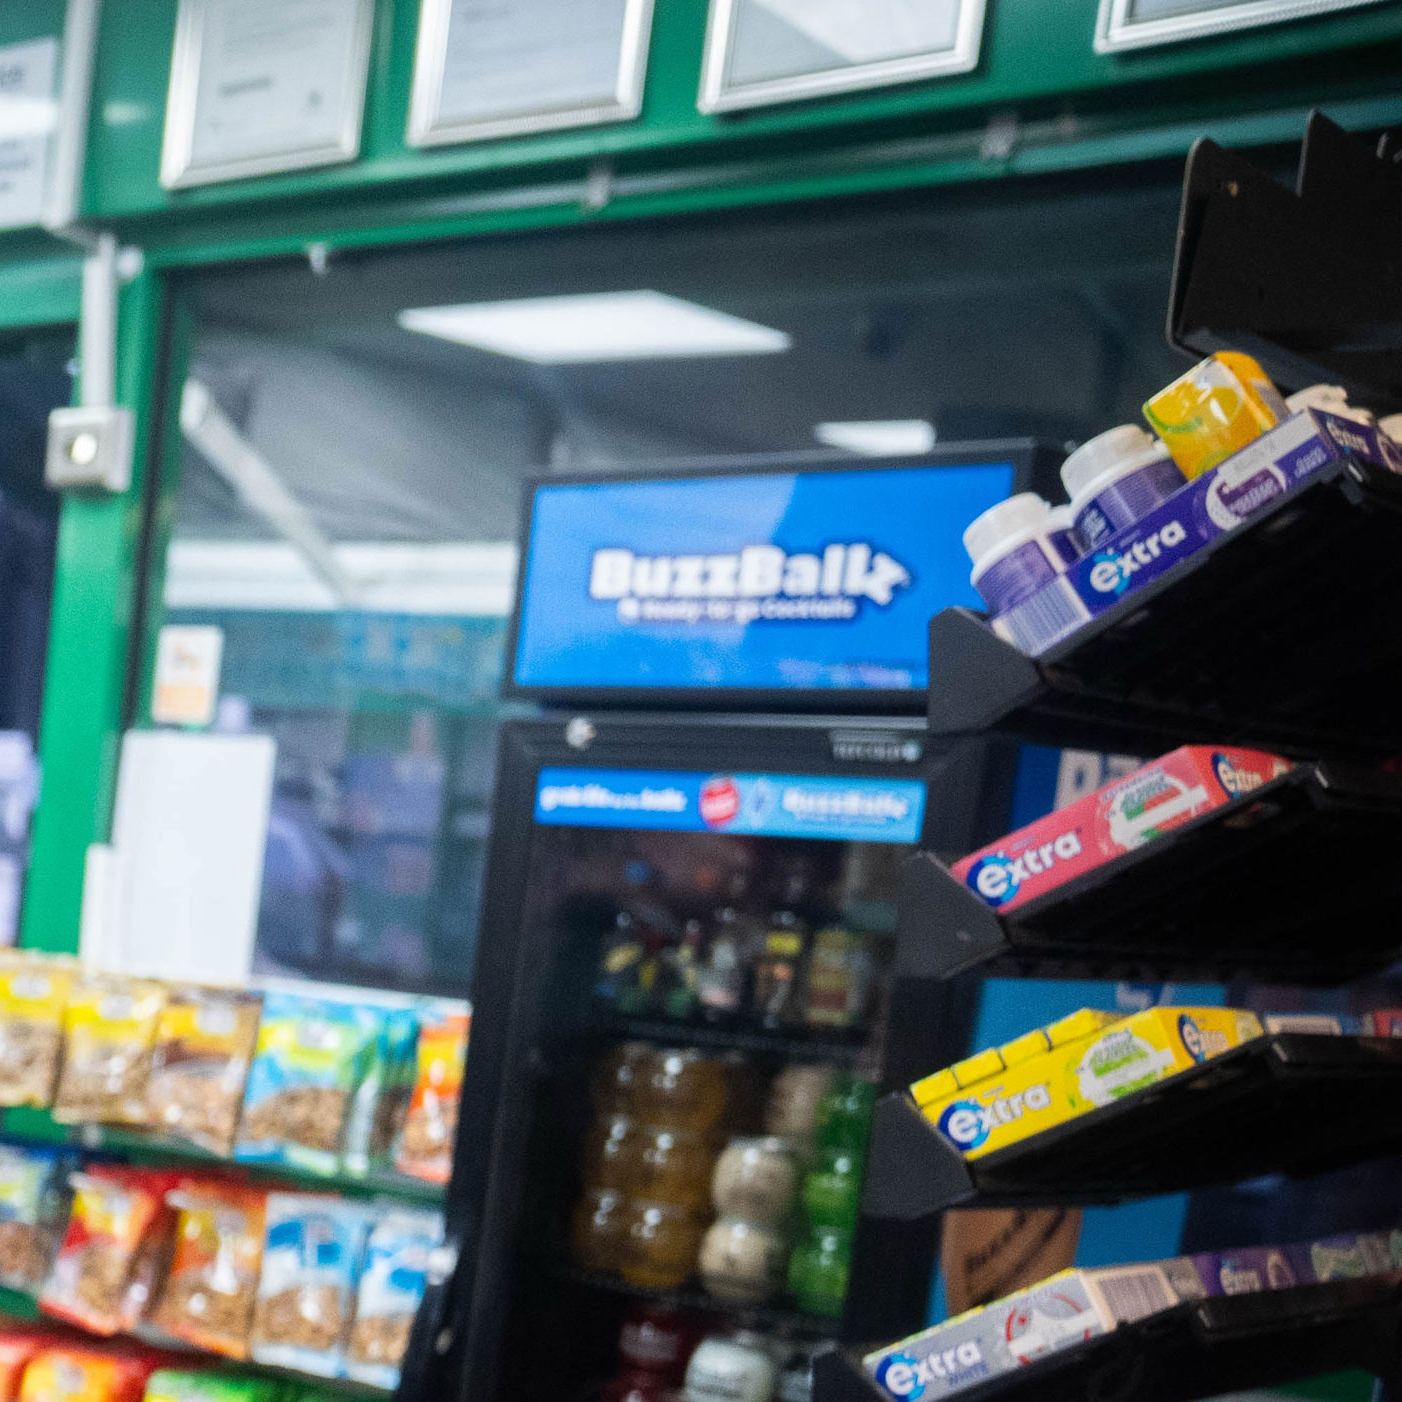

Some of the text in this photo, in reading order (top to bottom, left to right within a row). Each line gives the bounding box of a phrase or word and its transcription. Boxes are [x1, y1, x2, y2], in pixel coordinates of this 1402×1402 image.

[1090, 520, 1187, 593] extra
[977, 831, 1082, 898] extra
[948, 1083, 1051, 1140] extra
[885, 1340, 982, 1395] extra
